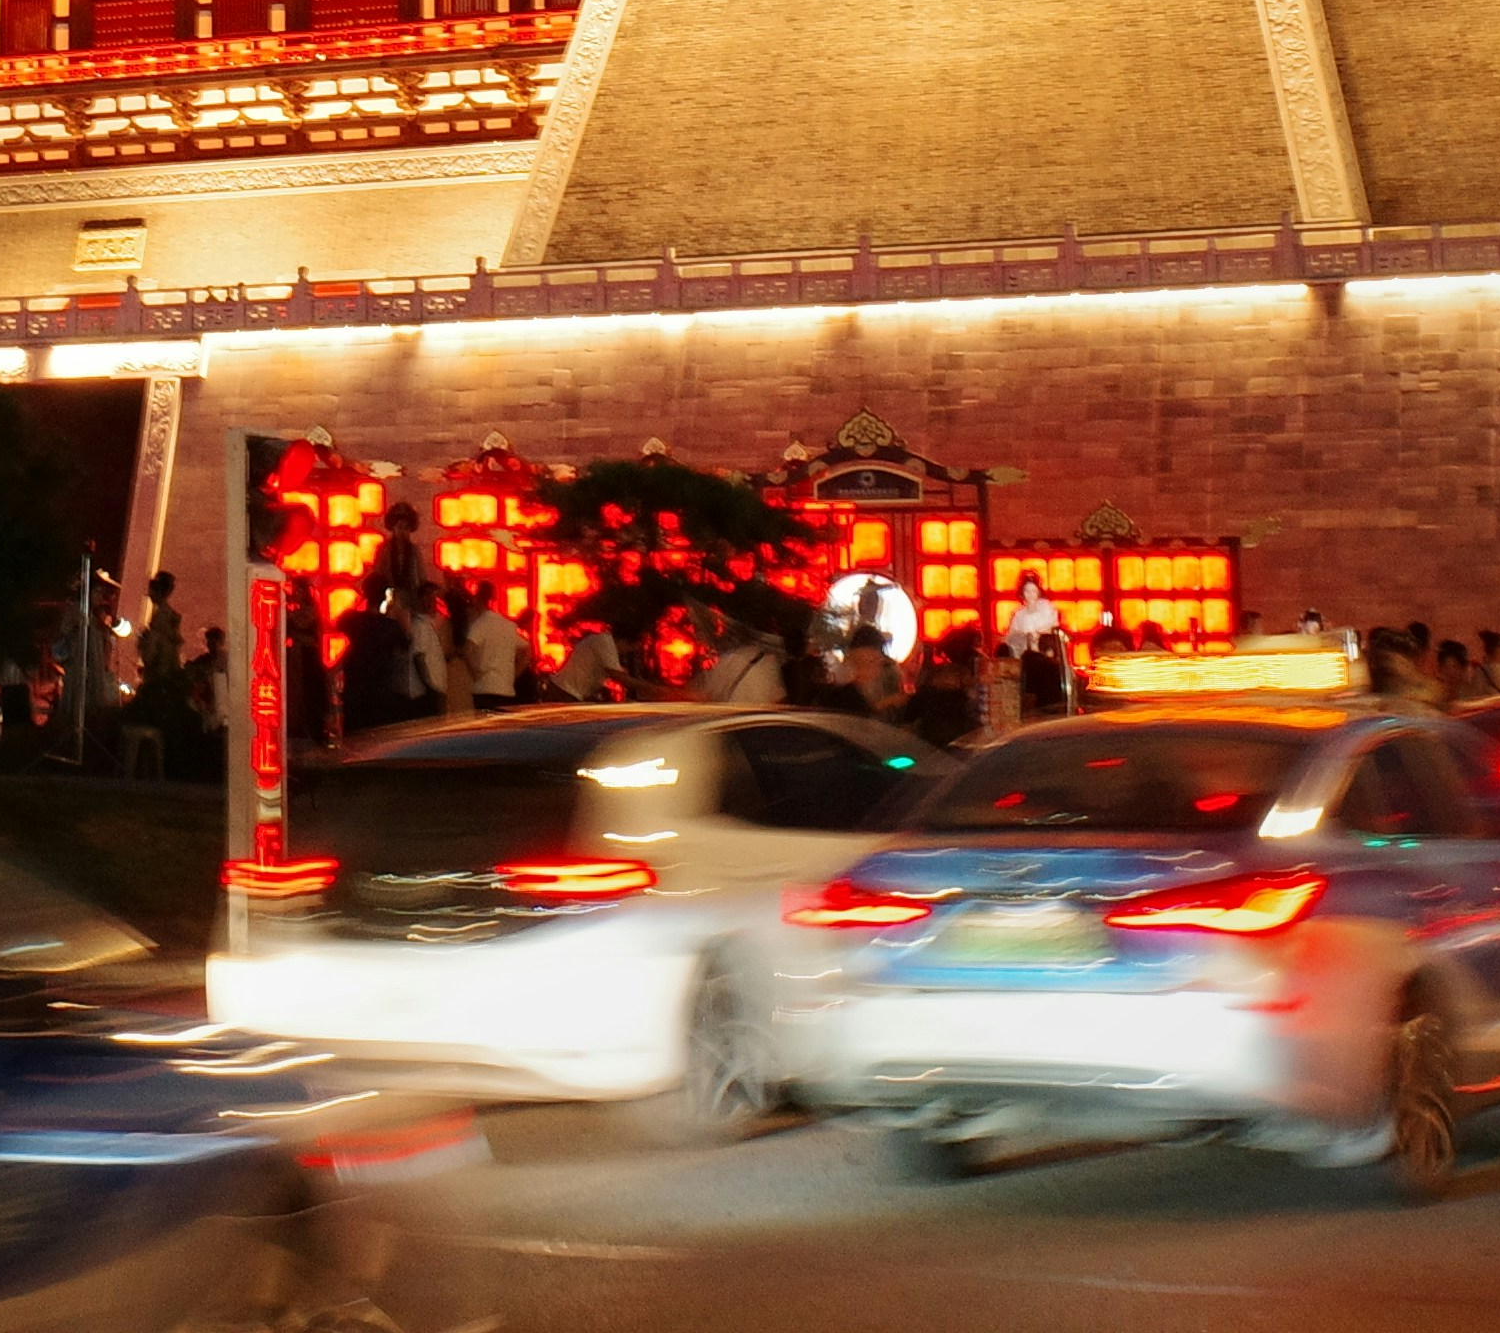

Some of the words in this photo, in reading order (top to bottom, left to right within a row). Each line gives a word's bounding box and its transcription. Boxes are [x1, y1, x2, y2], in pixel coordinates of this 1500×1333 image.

[252, 579, 281, 870] 行人禁止行
